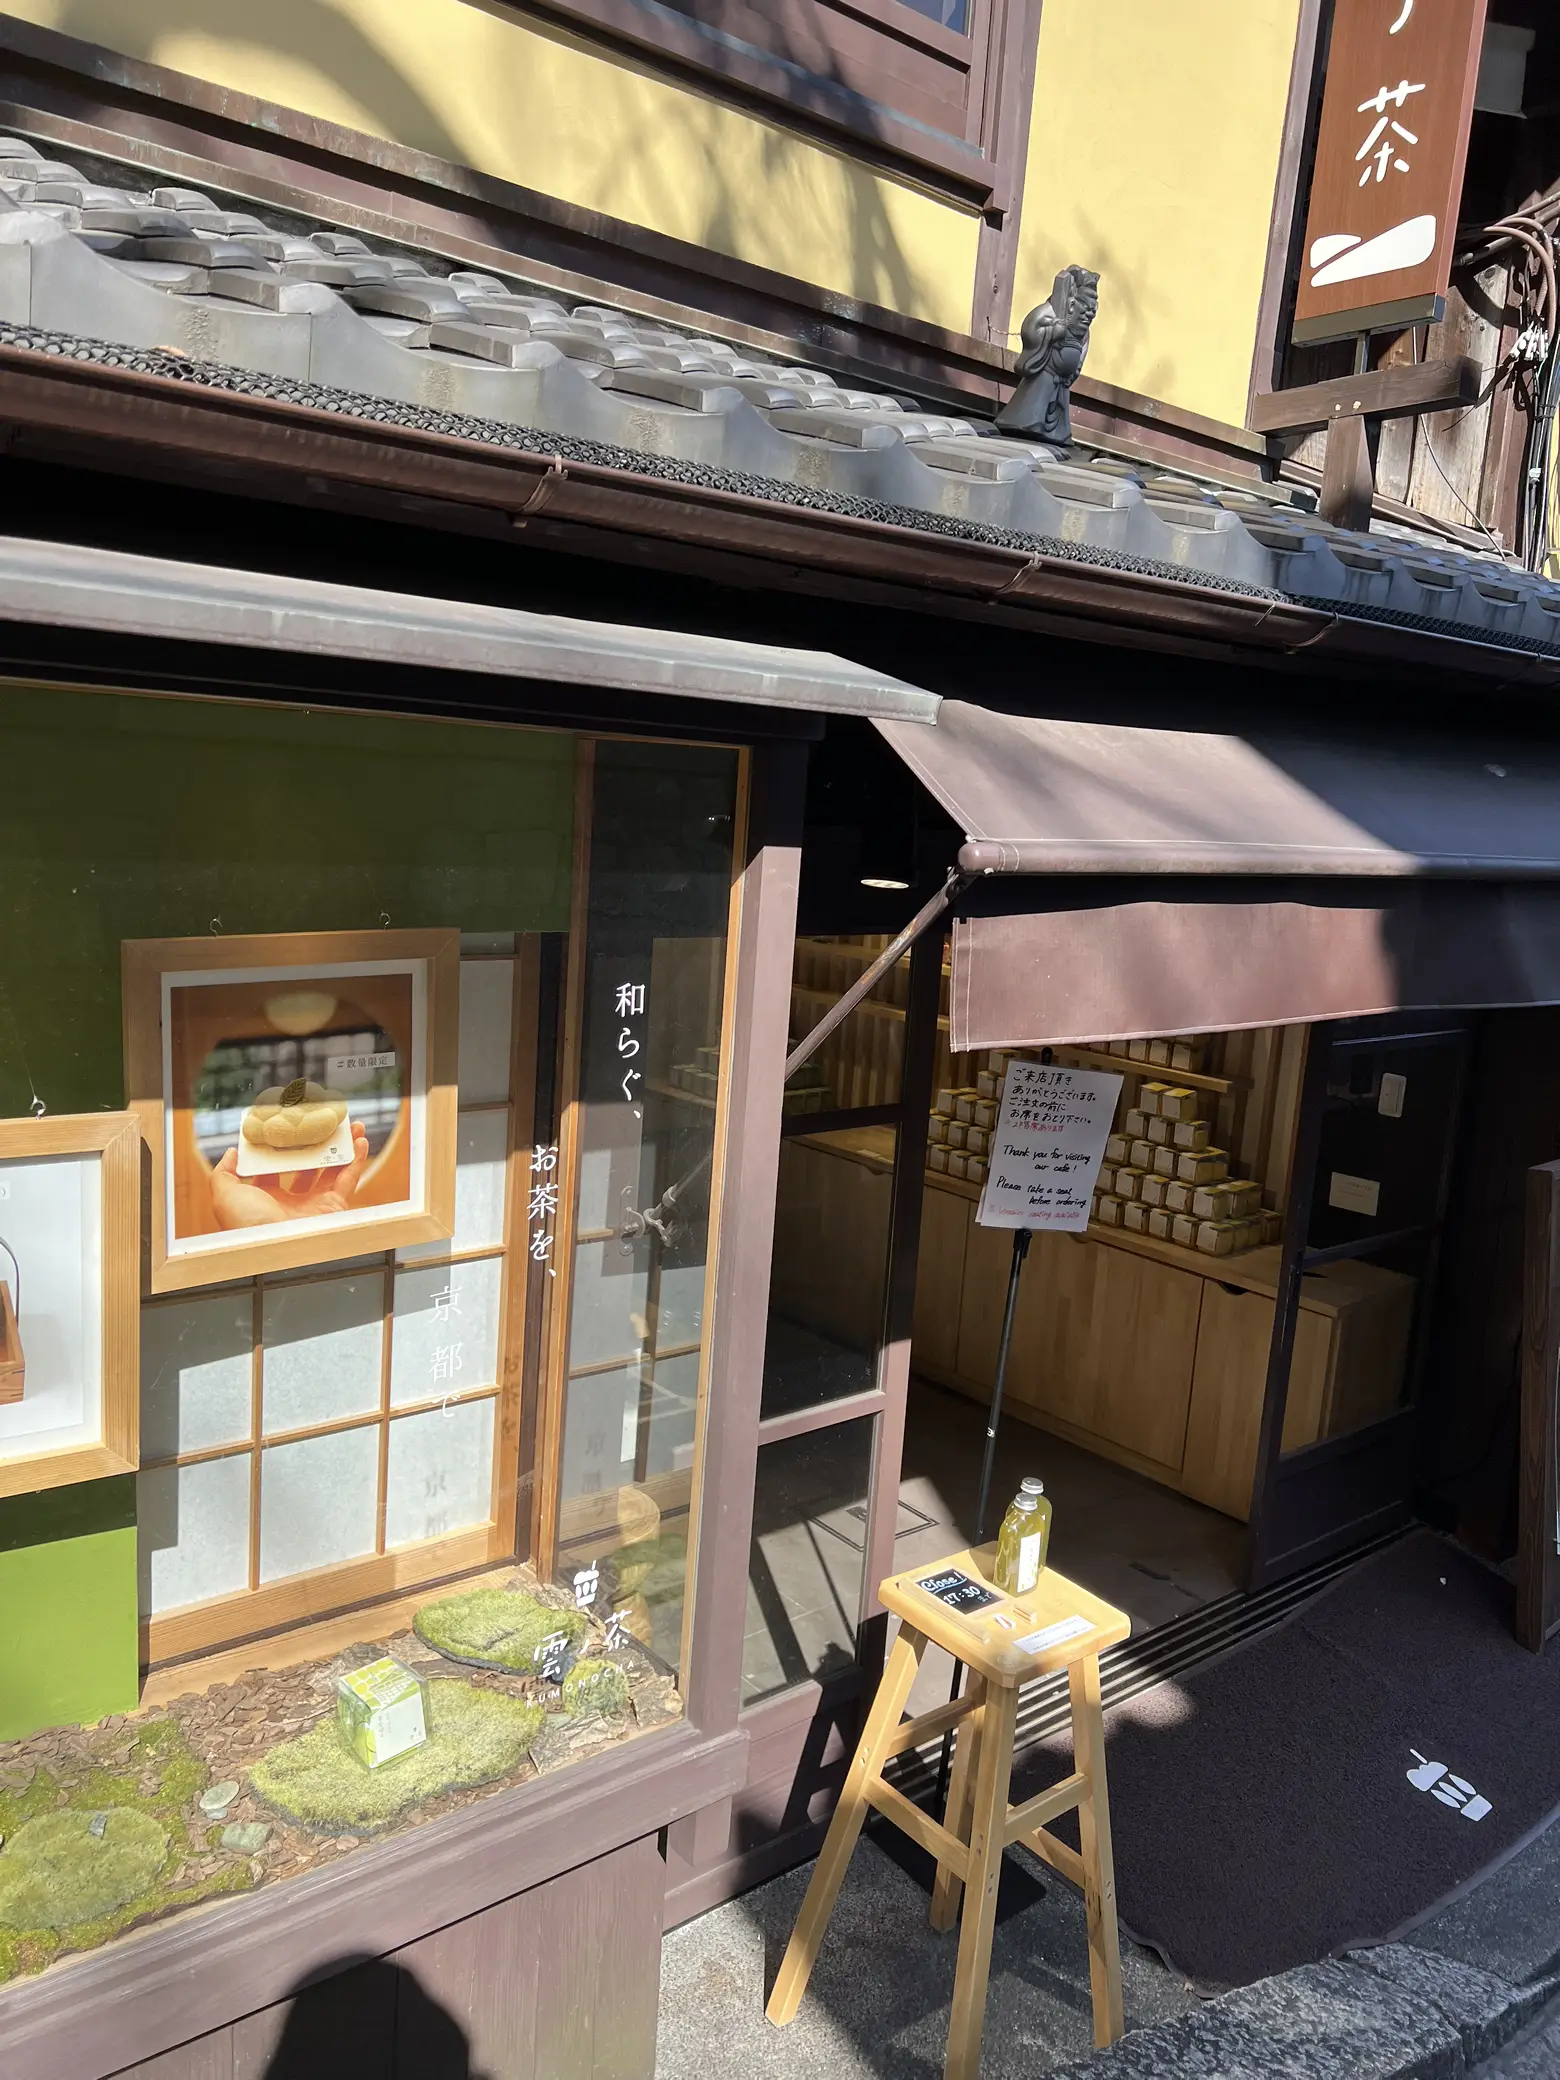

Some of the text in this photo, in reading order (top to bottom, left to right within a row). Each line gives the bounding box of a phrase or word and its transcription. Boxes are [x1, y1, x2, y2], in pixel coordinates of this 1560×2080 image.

[614, 982, 646, 1119] 和らぐ、
[1013, 1068, 1072, 1085] ご来店頂き
[1012, 1085, 1096, 1101] ありがとうございます。
[1009, 1097, 1067, 1112] ご注文の前に
[1009, 1109, 1091, 1124] お席をおとり下さい。
[1003, 1144, 1091, 1165] Thank you for visiting
[996, 1175, 1022, 1191] Please
[1027, 1184, 1045, 1194] take
[526, 1144, 559, 1278] お茶を、
[1028, 1196, 1087, 1208] before ordering
[428, 1285, 464, 1418] 京都で
[943, 1586, 981, 1605] 17:30
[526, 1659, 635, 1709] KUMONOCHA
